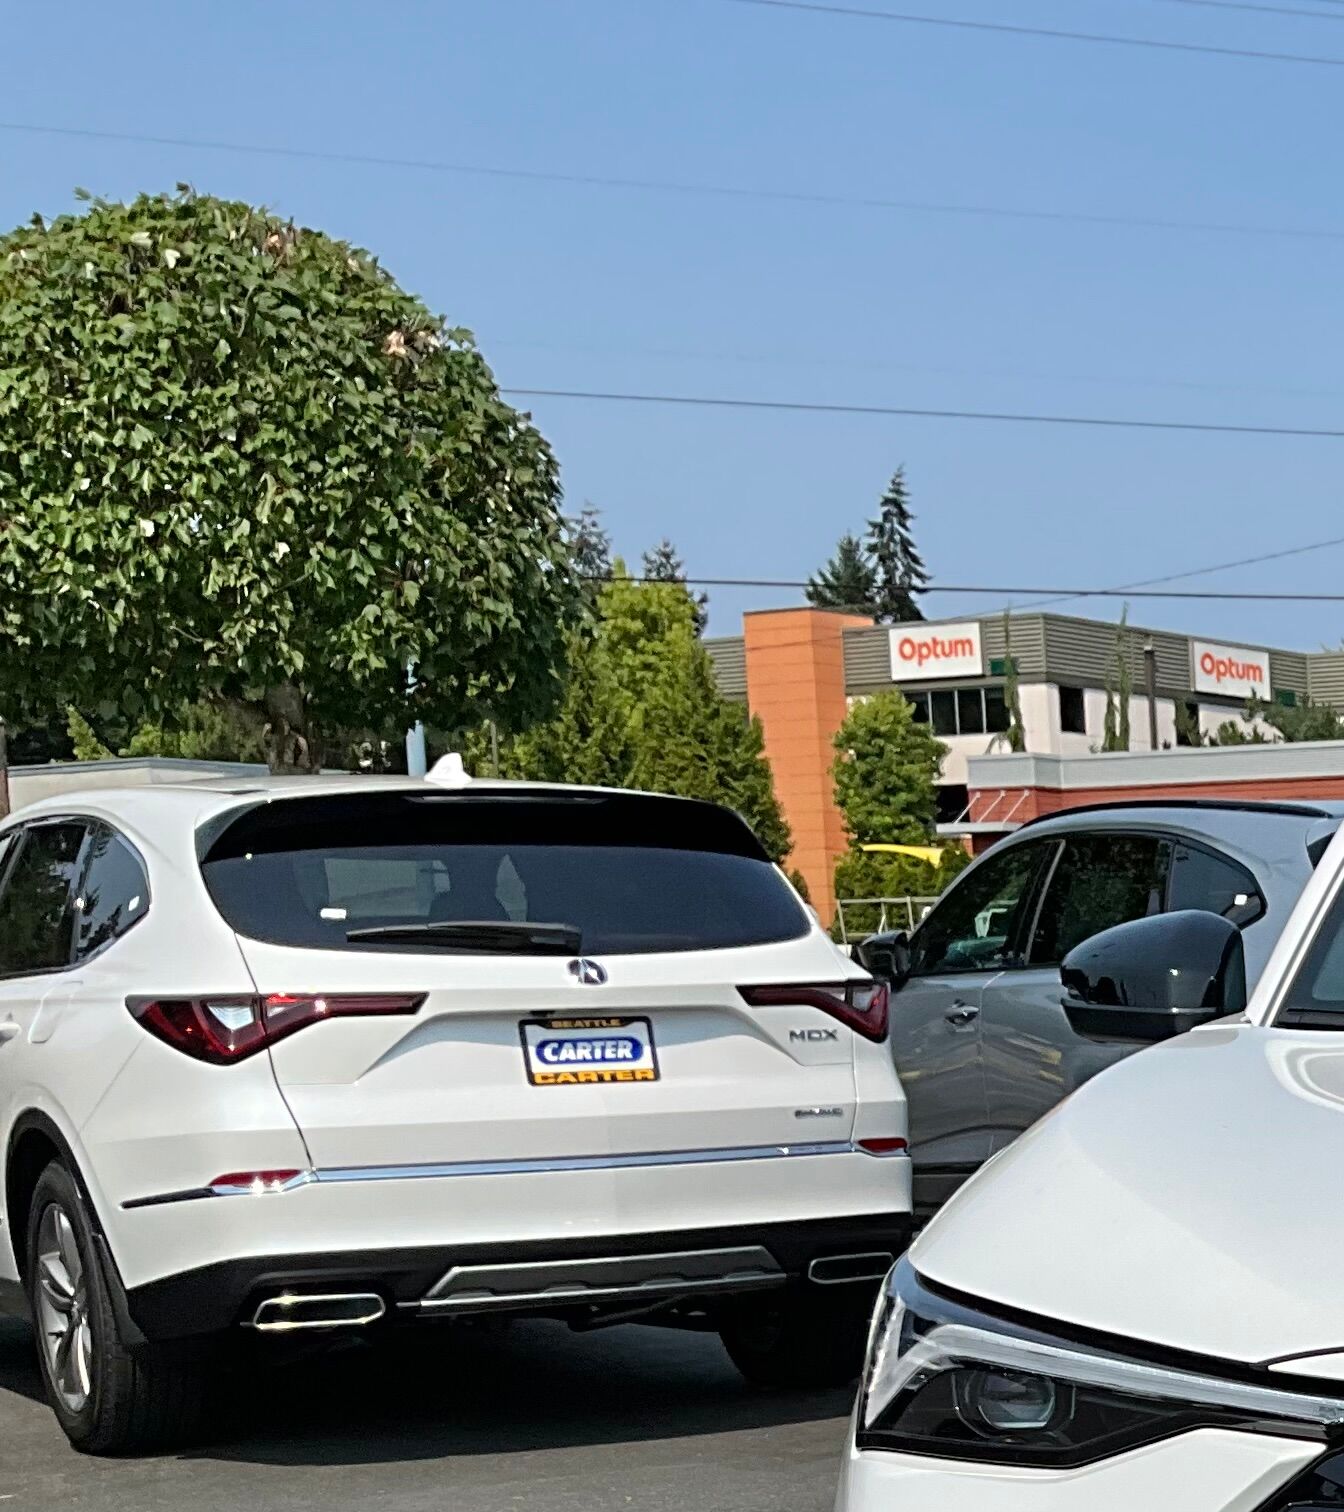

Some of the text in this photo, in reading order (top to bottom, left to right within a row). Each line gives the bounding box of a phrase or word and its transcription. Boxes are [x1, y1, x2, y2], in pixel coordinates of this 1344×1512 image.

[899, 637, 973, 667] Optum
[1200, 652, 1264, 684] Optum
[551, 1018, 621, 1028] SEATTLE
[789, 1029, 839, 1042] MDX
[543, 1040, 633, 1062] CARTER
[533, 1069, 656, 1084] CARTER
